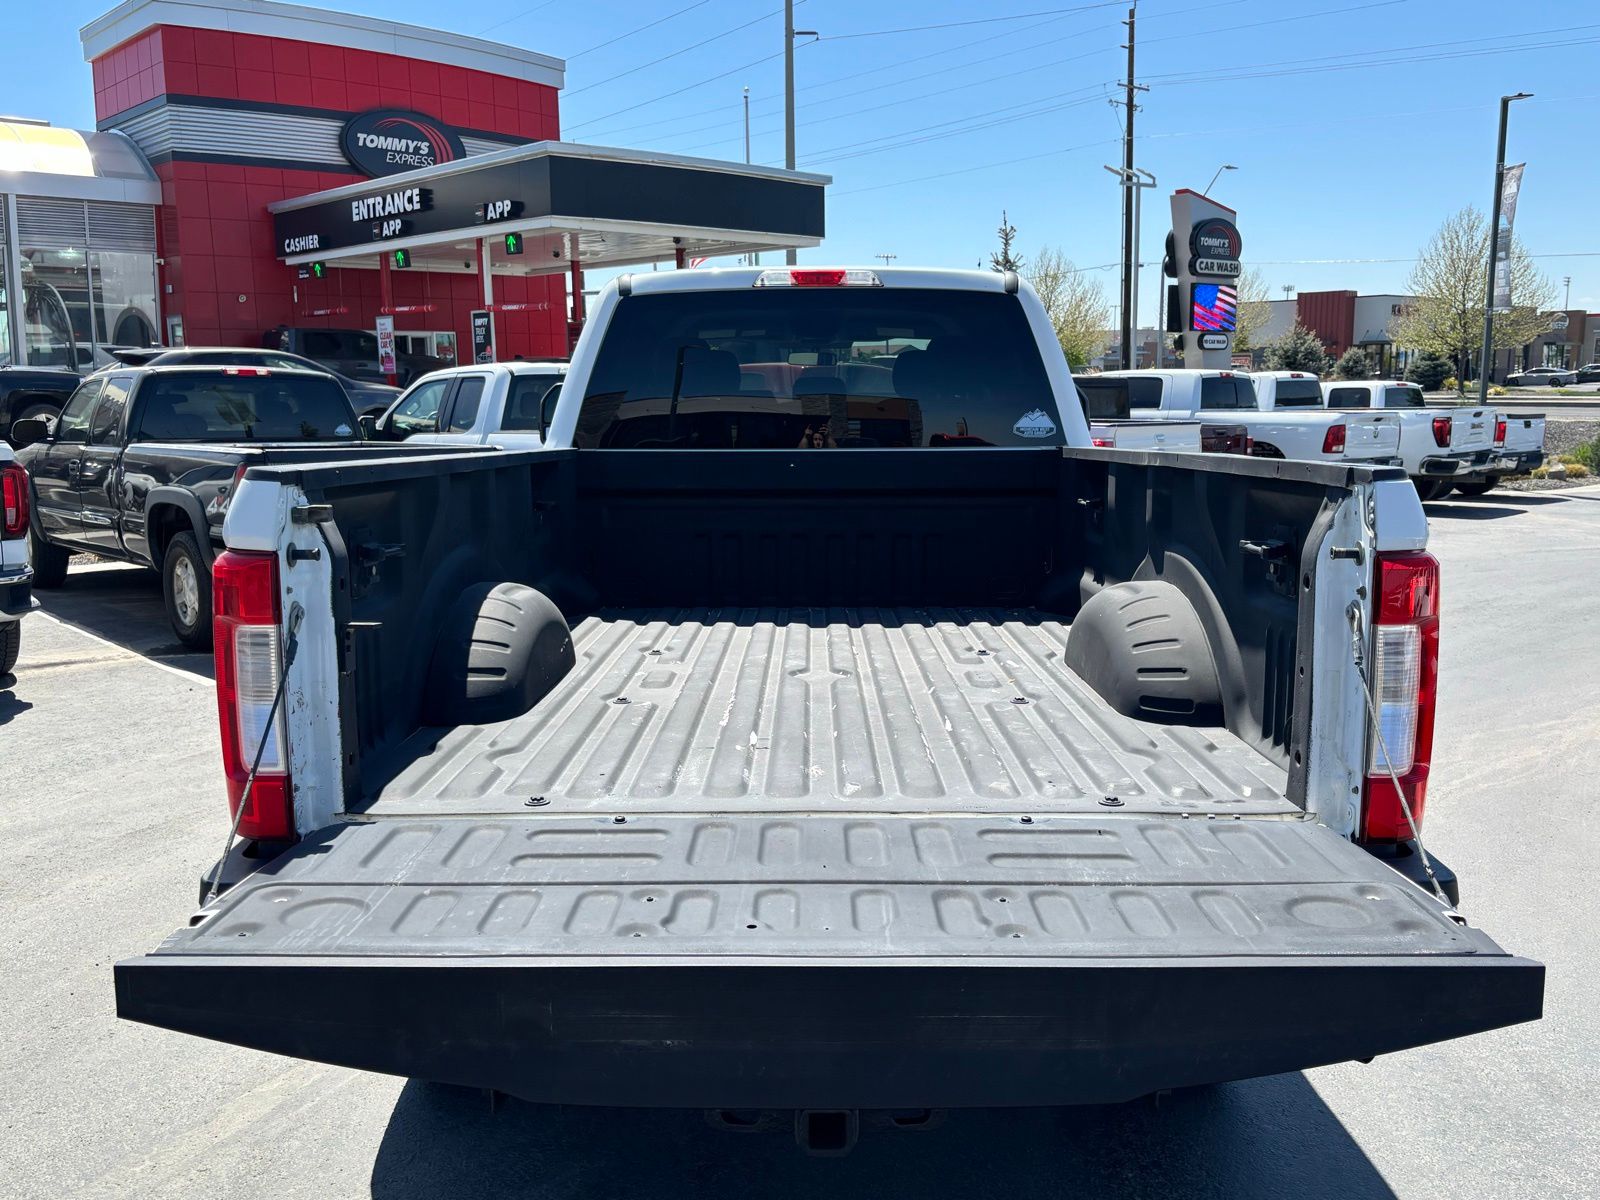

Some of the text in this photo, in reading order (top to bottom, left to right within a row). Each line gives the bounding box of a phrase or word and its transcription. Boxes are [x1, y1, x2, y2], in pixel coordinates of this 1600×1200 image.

[356, 133, 430, 155] TOMMY'S
[386, 151, 434, 167] EXPRESS
[352, 188, 420, 222] ENTRANCE
[486, 199, 512, 220] APP
[382, 218, 402, 237] APP
[284, 234, 320, 253] CASHIER
[1200, 237, 1229, 248] TOMMY'S
[1198, 260, 1239, 274] CAR WASH
